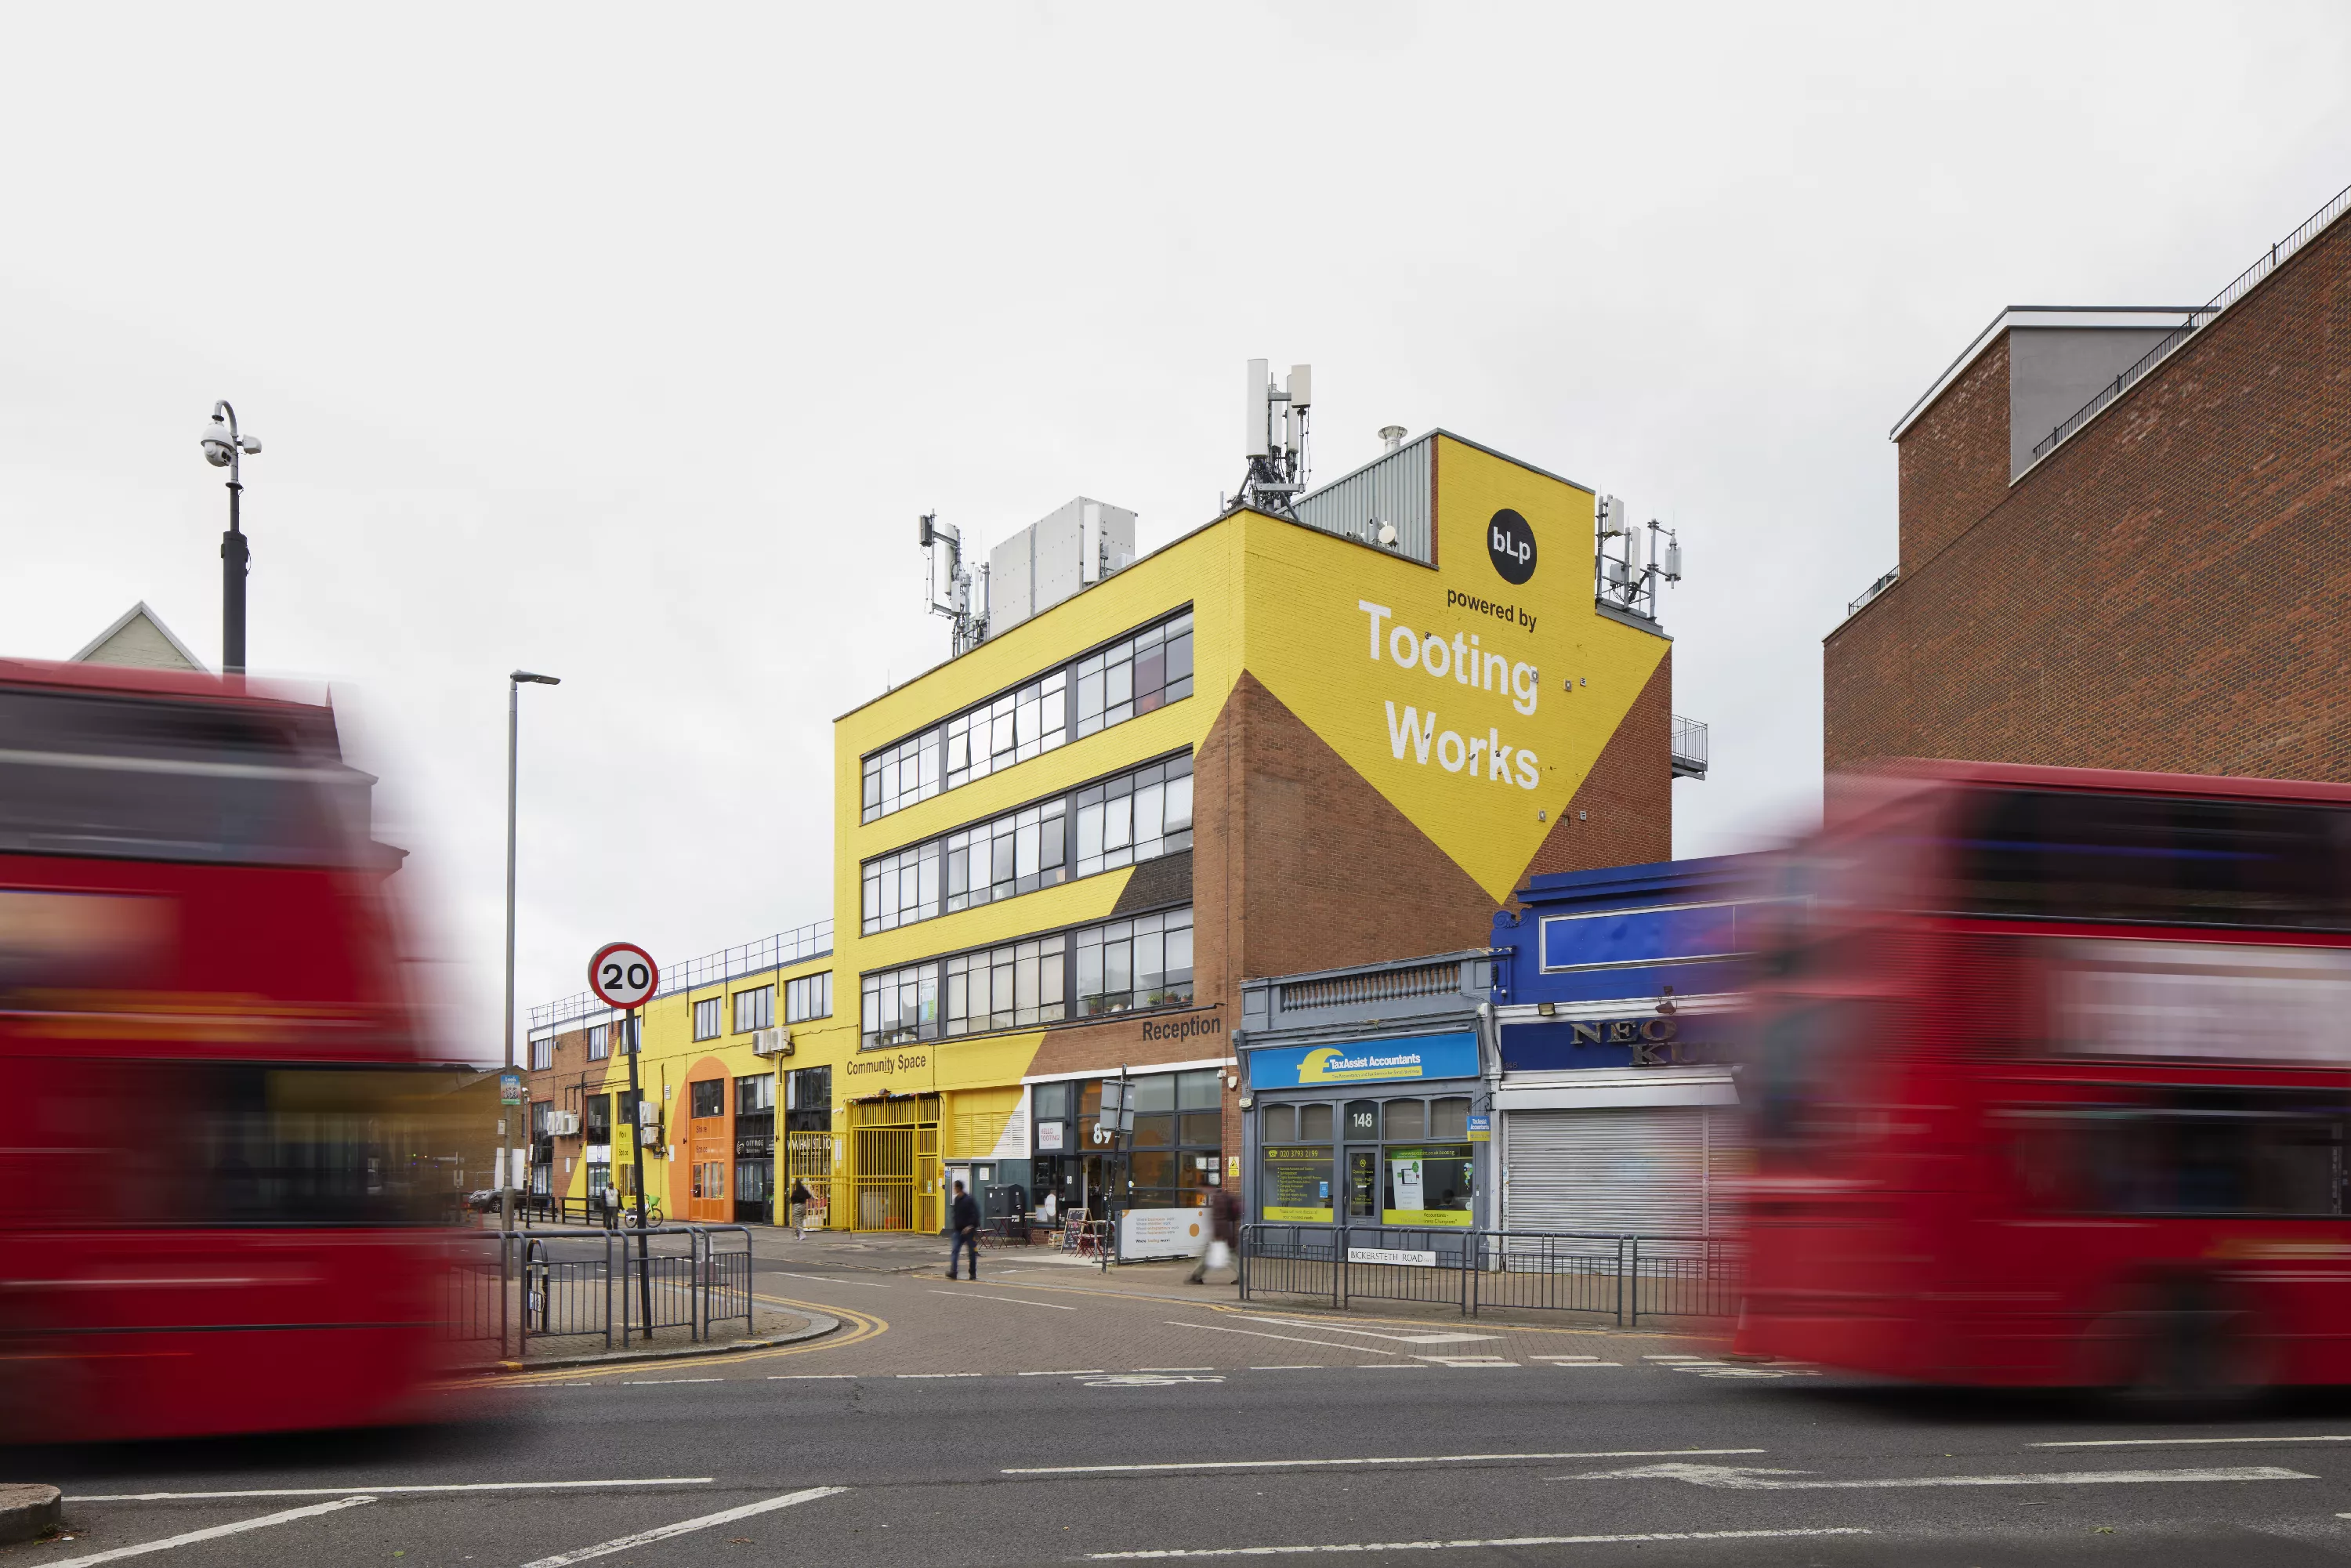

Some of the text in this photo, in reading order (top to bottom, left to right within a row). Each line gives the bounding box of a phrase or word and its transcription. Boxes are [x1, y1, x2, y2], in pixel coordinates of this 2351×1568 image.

[1493, 526, 1531, 565] bLp
[1447, 588, 1537, 633] powered by
[1358, 599, 1538, 716] Tooting
[1385, 700, 1540, 790] Works
[603, 963, 649, 990] 20
[1143, 1015, 1221, 1042] Reception
[1570, 1018, 1677, 1045] NEO
[846, 1054, 926, 1075] Community Space
[1330, 1053, 1421, 1070] TaxAssist Accountants
[1353, 1113, 1372, 1128] 148
[1350, 1251, 1398, 1261] BICKERSTETH
[1402, 1253, 1424, 1262] ROAD
